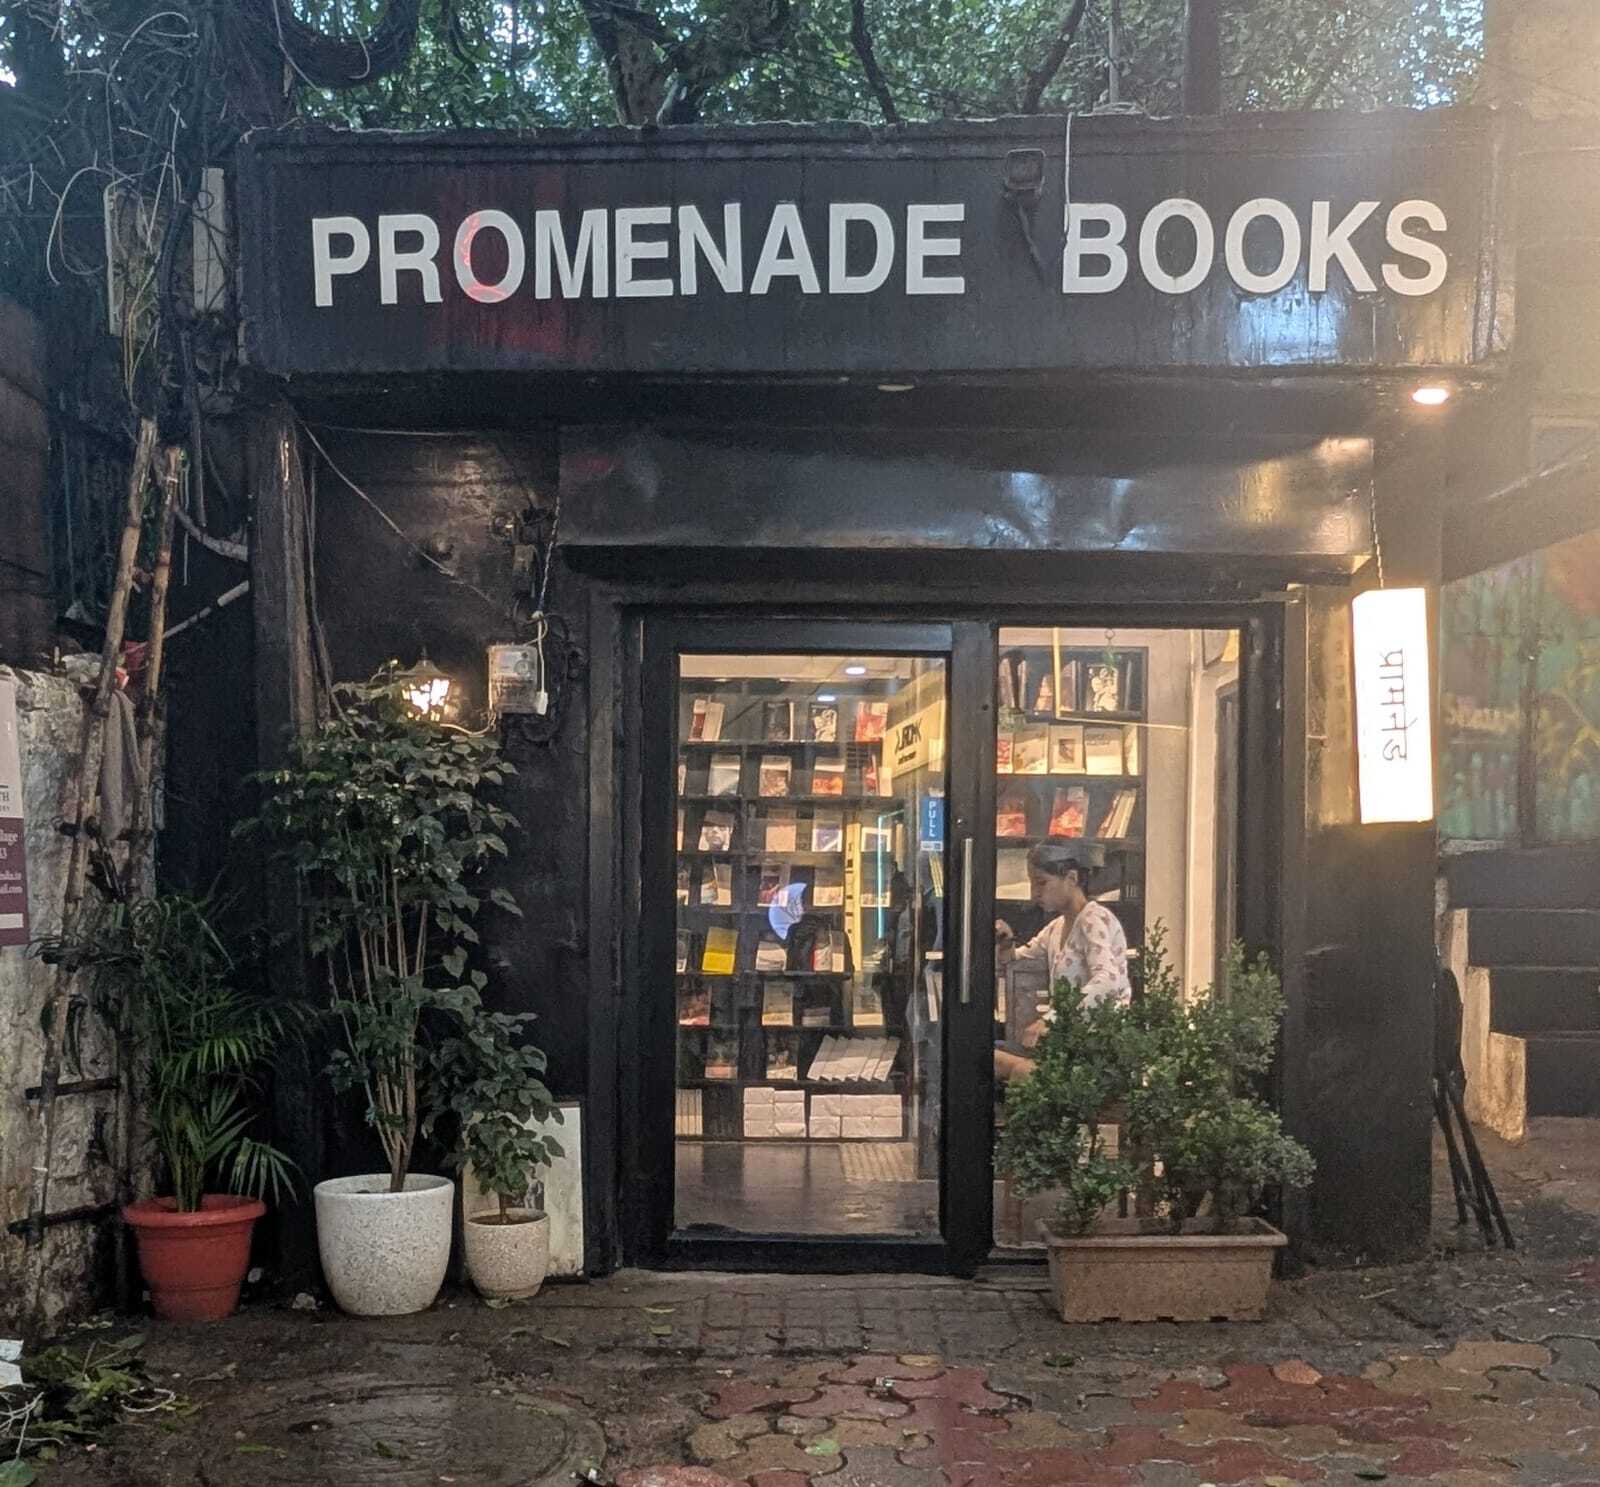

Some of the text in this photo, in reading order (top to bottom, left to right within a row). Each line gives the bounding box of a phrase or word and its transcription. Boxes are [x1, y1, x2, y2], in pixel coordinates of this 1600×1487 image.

[312, 198, 1449, 307] PROMENADE BOOKS
[928, 800, 938, 837] PULL
